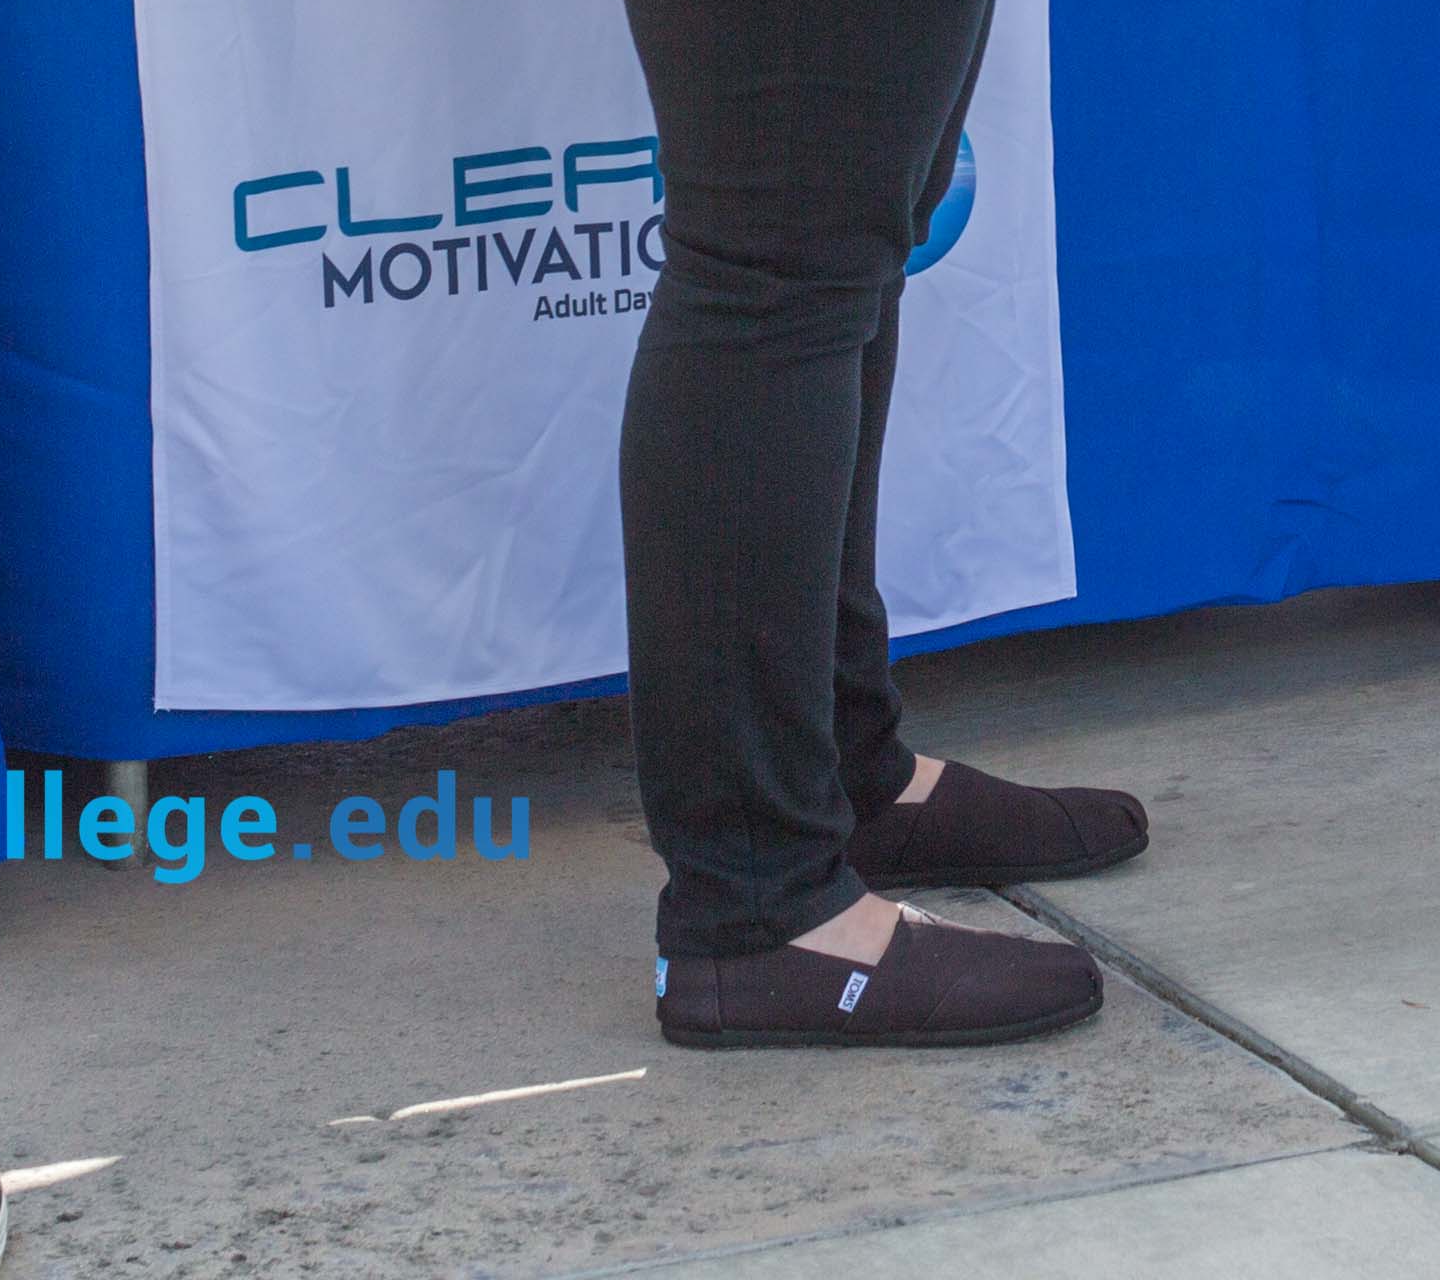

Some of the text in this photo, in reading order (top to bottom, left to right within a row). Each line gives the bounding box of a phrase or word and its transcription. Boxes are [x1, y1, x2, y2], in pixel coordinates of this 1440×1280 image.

[233, 136, 664, 252] CLEA
[533, 291, 608, 322] Adult
[842, 978, 864, 1009] TOMS
